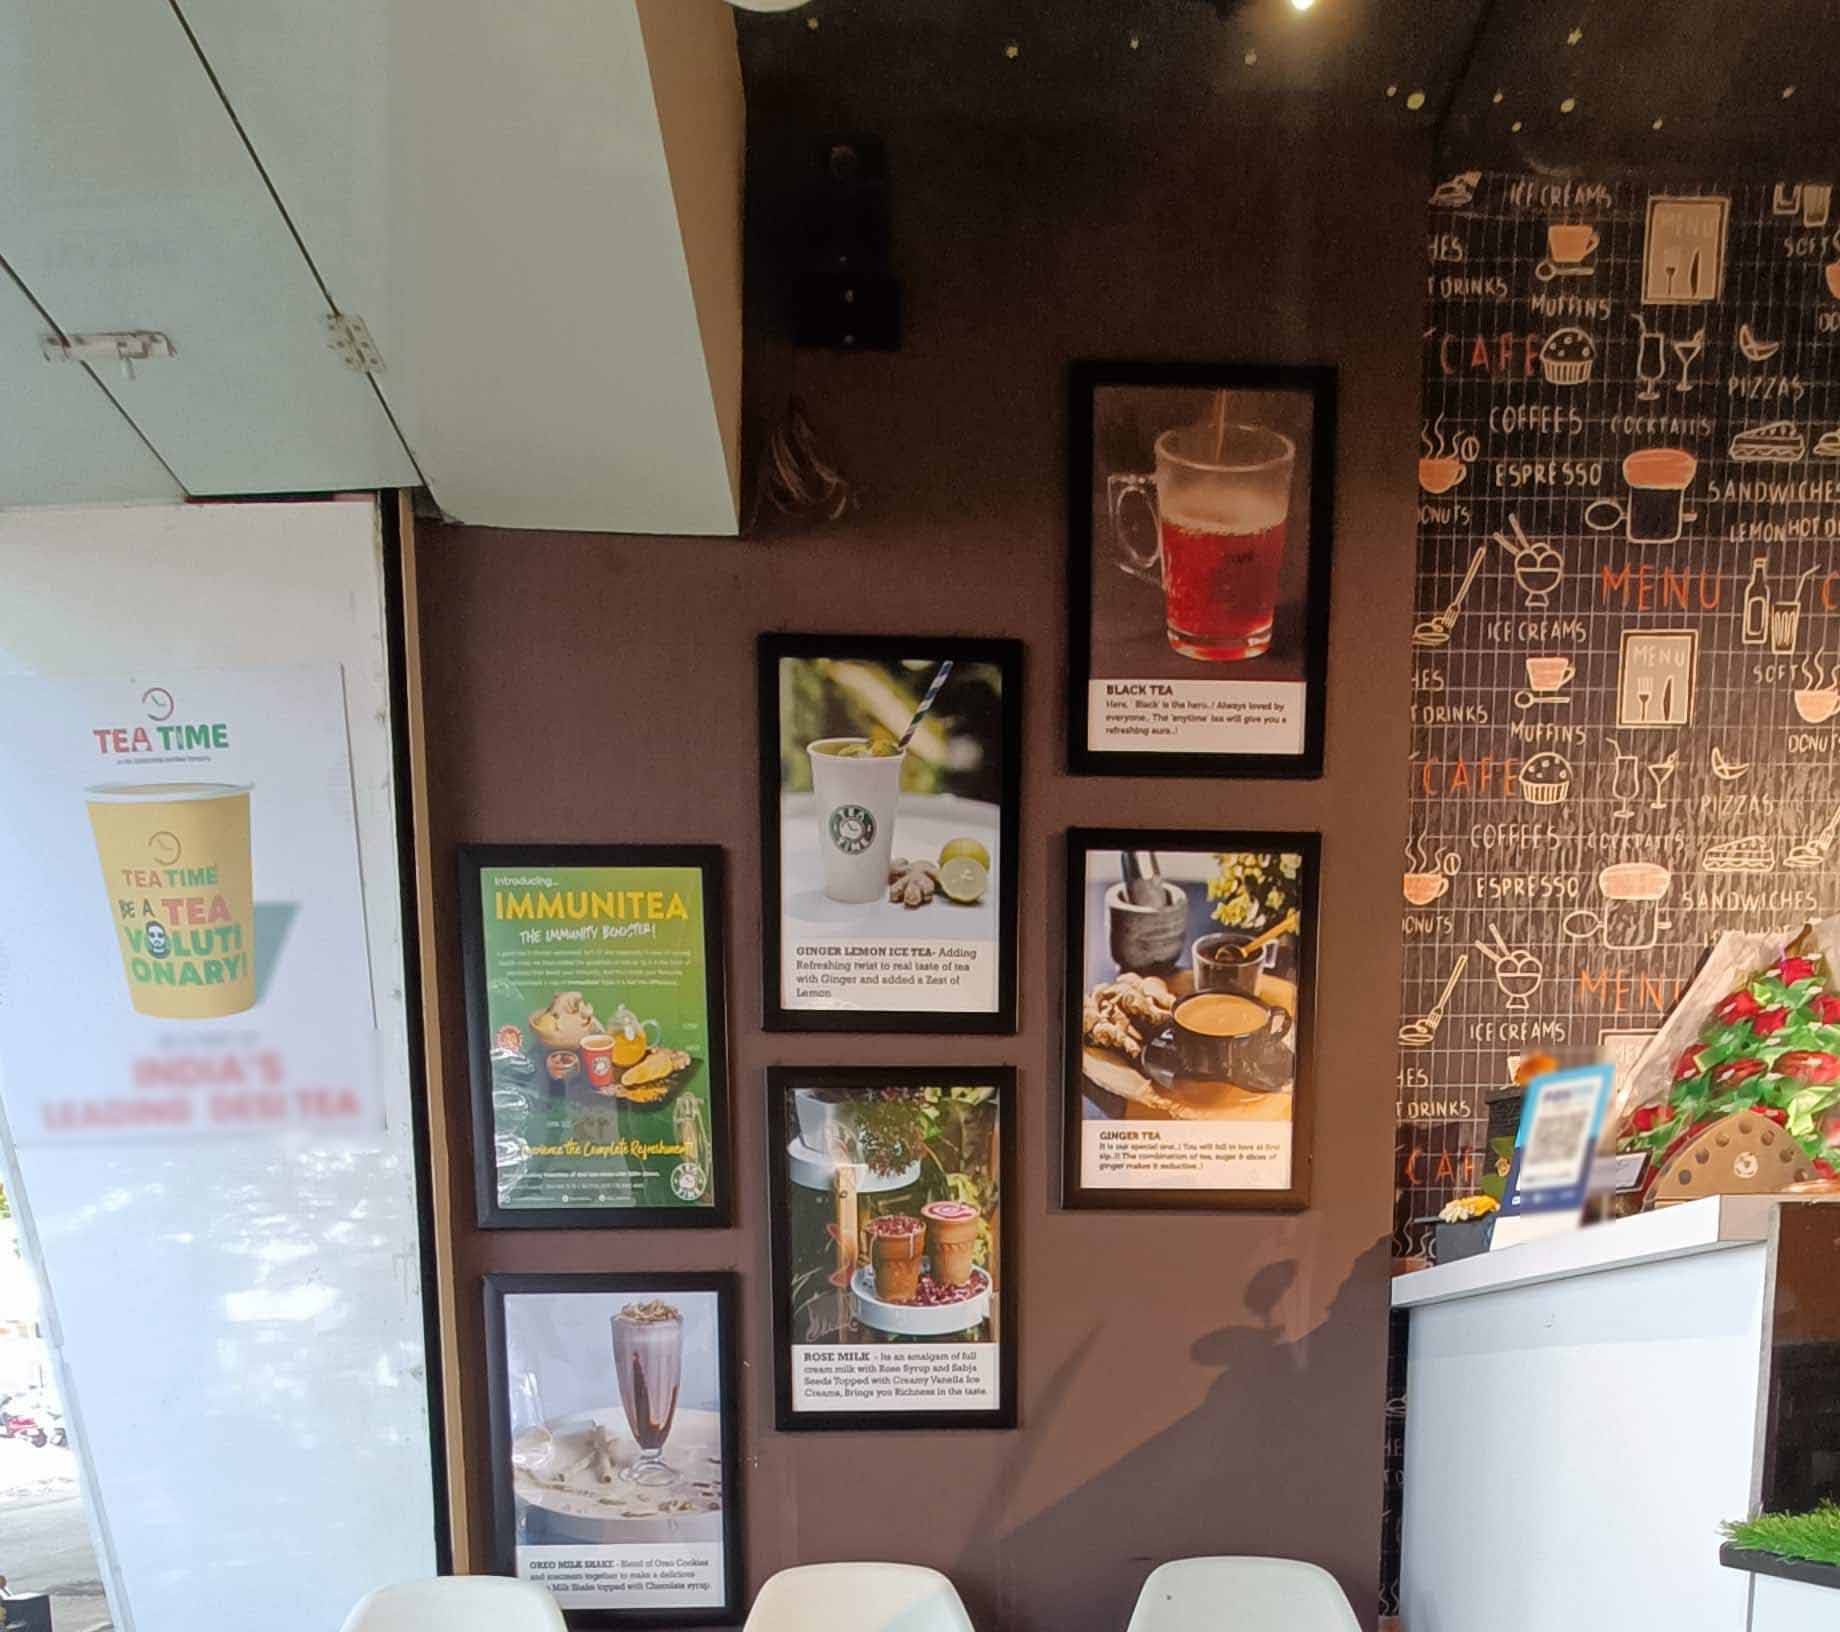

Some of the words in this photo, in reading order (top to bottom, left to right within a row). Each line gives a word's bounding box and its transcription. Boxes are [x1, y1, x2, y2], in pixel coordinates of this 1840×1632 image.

[1541, 183, 1614, 208] CREAMS
[1438, 276, 1508, 299] DRINKS
[1530, 295, 1610, 321] MUFFINS
[1440, 334, 1539, 377] CAFE
[1728, 374, 1804, 399] PIZZAS
[1488, 406, 1583, 435] COFFEES
[1610, 415, 1712, 437] COCKTAILS
[1494, 459, 1601, 488] ESPRESSO
[1418, 504, 1470, 526] ONUTS
[1729, 520, 1786, 544] LEMON
[1600, 563, 1721, 611] MENU
[1487, 620, 1513, 641] ICE
[1518, 619, 1587, 642] CREAMS
[1632, 646, 1686, 668] MENU
[1753, 663, 1798, 683] SOFT
[1106, 684, 1146, 695] BLACK
[1149, 684, 1174, 696] TEA
[1216, 700, 1246, 712] Always
[1248, 702, 1272, 711] loved
[1273, 702, 1285, 712] by
[1422, 704, 1489, 725] DRINKS
[1226, 714, 1242, 723] will
[1244, 715, 1262, 725] give
[1264, 716, 1280, 725] you
[93, 726, 153, 754] TEA
[156, 723, 230, 751] TIME
[1105, 726, 1149, 736] refreshing
[1510, 720, 1587, 745] MUFFINS
[1422, 757, 1521, 798] CAFE
[1700, 793, 1774, 817] PIZZAS
[1470, 824, 1560, 850] COFFEES
[121, 870, 162, 888] TEA
[165, 866, 219, 888] TIME
[1477, 874, 1580, 899] ESPRESSO
[160, 895, 232, 926] TEA
[494, 891, 689, 922] IMMUNITEA
[1682, 890, 1818, 912] SANDWICHES
[519, 927, 542, 945] THE
[545, 924, 599, 943] IMMUNITY
[796, 946, 842, 957] GINGER
[844, 946, 887, 957] LEMON
[889, 947, 909, 957] ICE
[939, 947, 976, 960] Adding
[796, 960, 852, 973] Refreshing
[854, 961, 878, 971] twist
[881, 961, 890, 971] to
[893, 961, 912, 971] real
[915, 962, 940, 971] taste
[942, 962, 952, 971] of
[955, 963, 970, 972] tea
[796, 974, 818, 984] with
[820, 974, 857, 986] Ginger
[860, 974, 879, 985] and
[882, 975, 915, 985] added
[950, 975, 960, 985] of
[1578, 969, 1681, 1012] MEN
[1470, 1021, 1495, 1041] ICE
[1499, 1020, 1567, 1042] CREAMS
[1408, 1099, 1472, 1120] DRINKS
[1099, 1131, 1138, 1140] GINGER
[1141, 1131, 1160, 1140] TEA
[1405, 1145, 1477, 1185] CAF
[804, 1352, 835, 1361] ROSE
[838, 1352, 870, 1361] MILK
[907, 1352, 949, 1362] amalgam
[951, 1352, 960, 1360] of
[962, 1351, 977, 1360] full
[835, 1365, 855, 1373] milk
[857, 1364, 877, 1373] with
[903, 1363, 930, 1375] Syrup
[933, 1363, 950, 1372] and
[833, 1376, 870, 1387] Topped
[871, 1376, 892, 1385] with
[893, 1375, 929, 1386] Creamy
[845, 1388, 874, 1399] Brings
[876, 1389, 893, 1398] you
[937, 1387, 946, 1396] in
[948, 1387, 962, 1396] the
[529, 1561, 556, 1569] OREO
[558, 1560, 582, 1569] MILK
[585, 1560, 616, 1569] SHAKE
